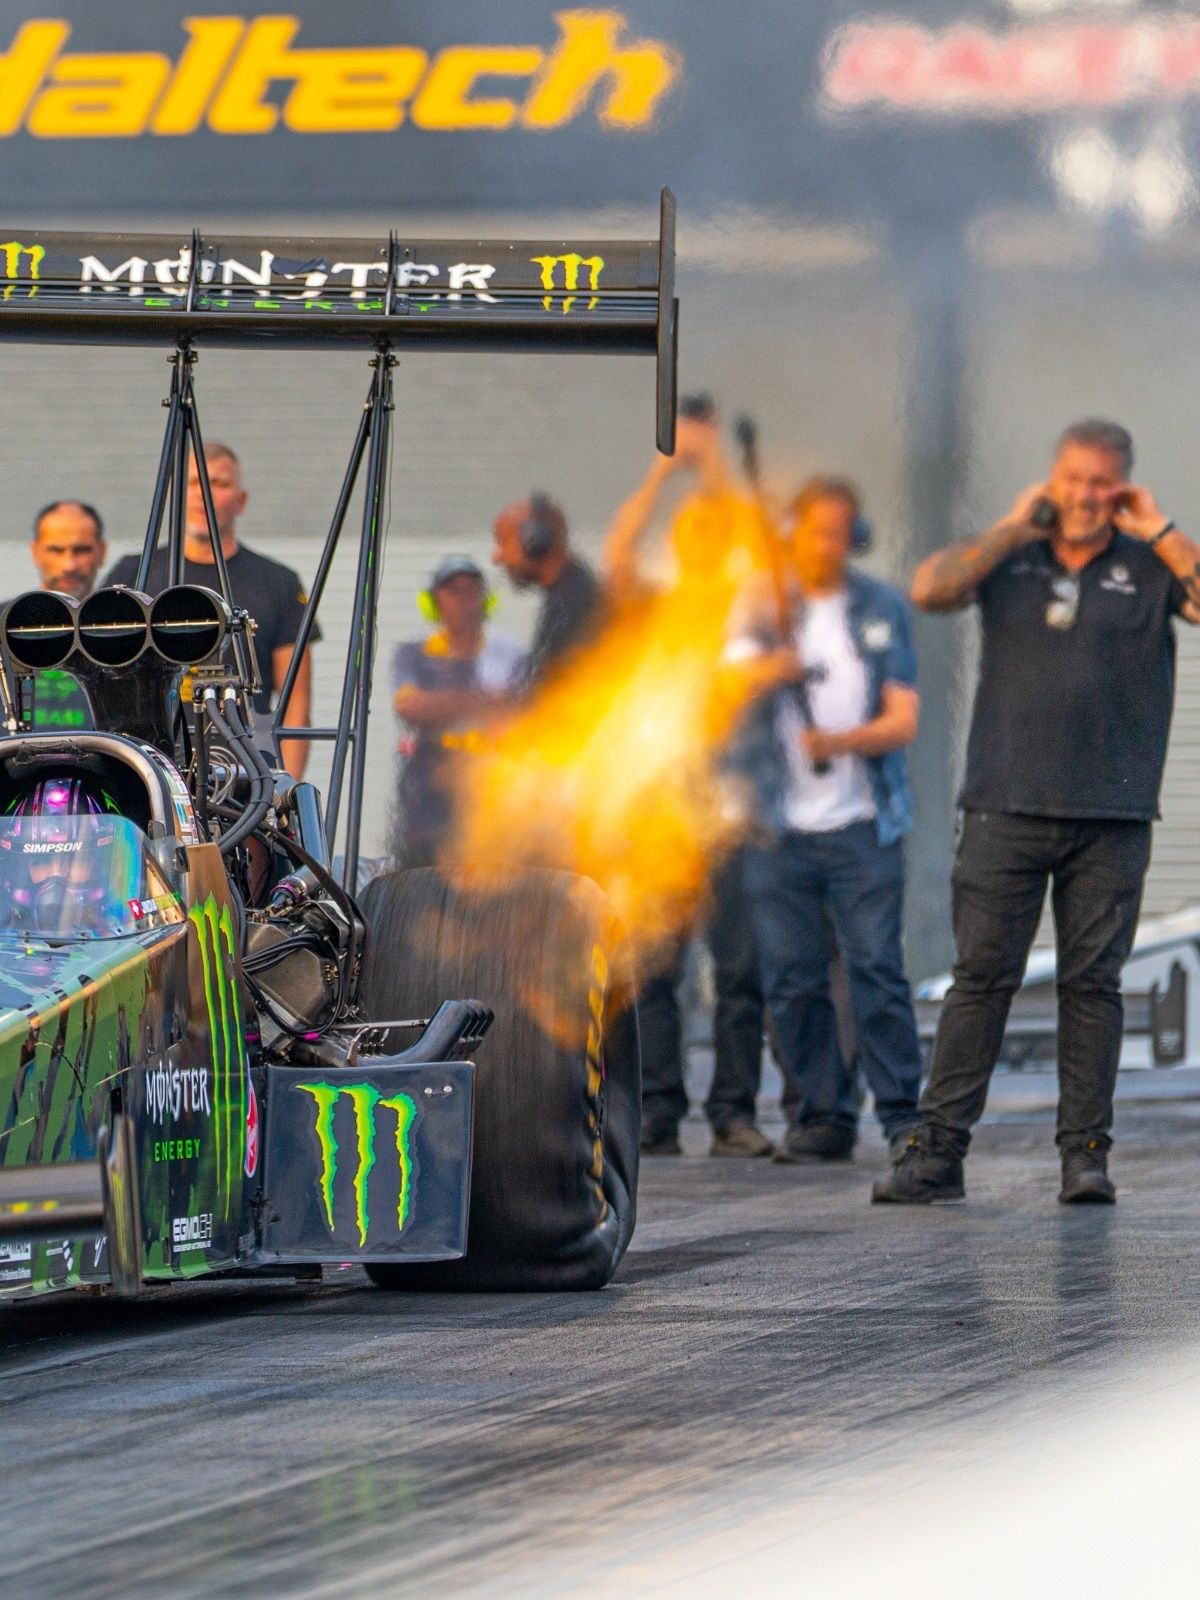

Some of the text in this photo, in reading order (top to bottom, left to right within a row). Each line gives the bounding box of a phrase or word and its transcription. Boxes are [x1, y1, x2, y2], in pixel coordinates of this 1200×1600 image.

[22, 841, 83, 853] SIMPSON
[145, 1059, 211, 1126] MONSTER
[154, 1139, 201, 1162] ENERGY
